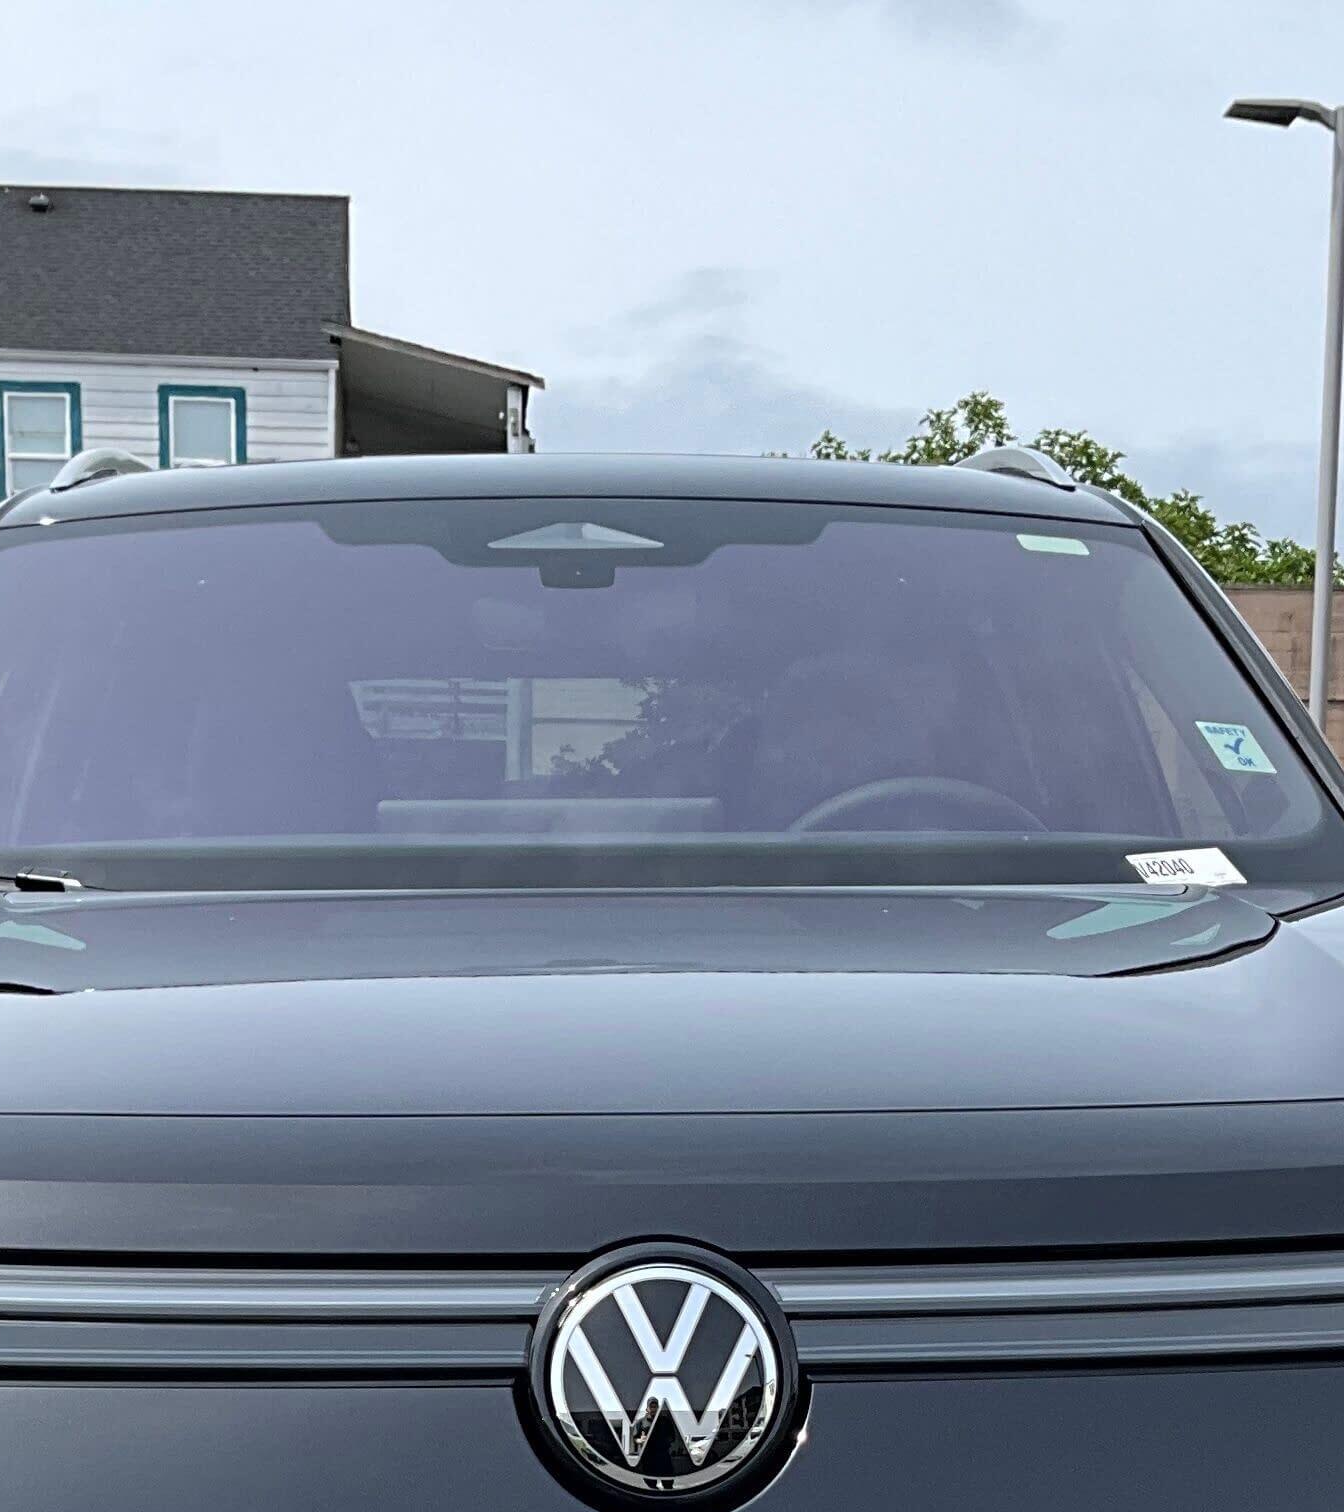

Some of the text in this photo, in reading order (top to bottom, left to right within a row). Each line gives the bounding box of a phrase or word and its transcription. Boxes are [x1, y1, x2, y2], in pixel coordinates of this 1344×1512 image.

[1203, 725, 1246, 737] SAFETY
[1237, 756, 1256, 767] OK
[562, 1280, 761, 1470] VW
